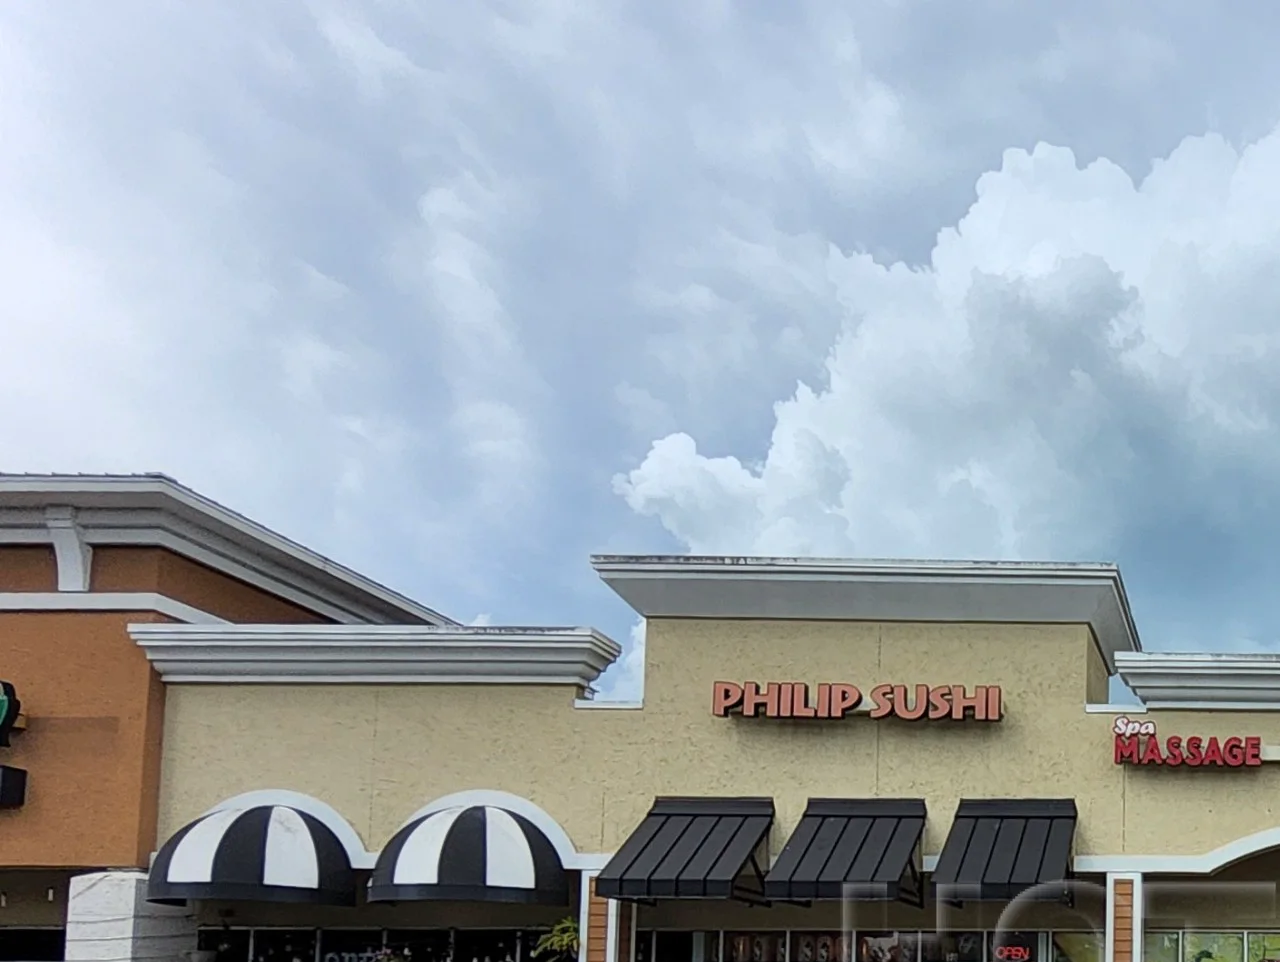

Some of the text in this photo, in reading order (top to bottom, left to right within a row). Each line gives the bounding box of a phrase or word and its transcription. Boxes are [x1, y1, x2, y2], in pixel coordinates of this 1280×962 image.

[712, 681, 1003, 721] PHILIP SUSHI
[1113, 716, 1156, 737] Spa
[1114, 735, 1262, 767] MASSAGE
[995, 946, 1031, 960] OPEN
